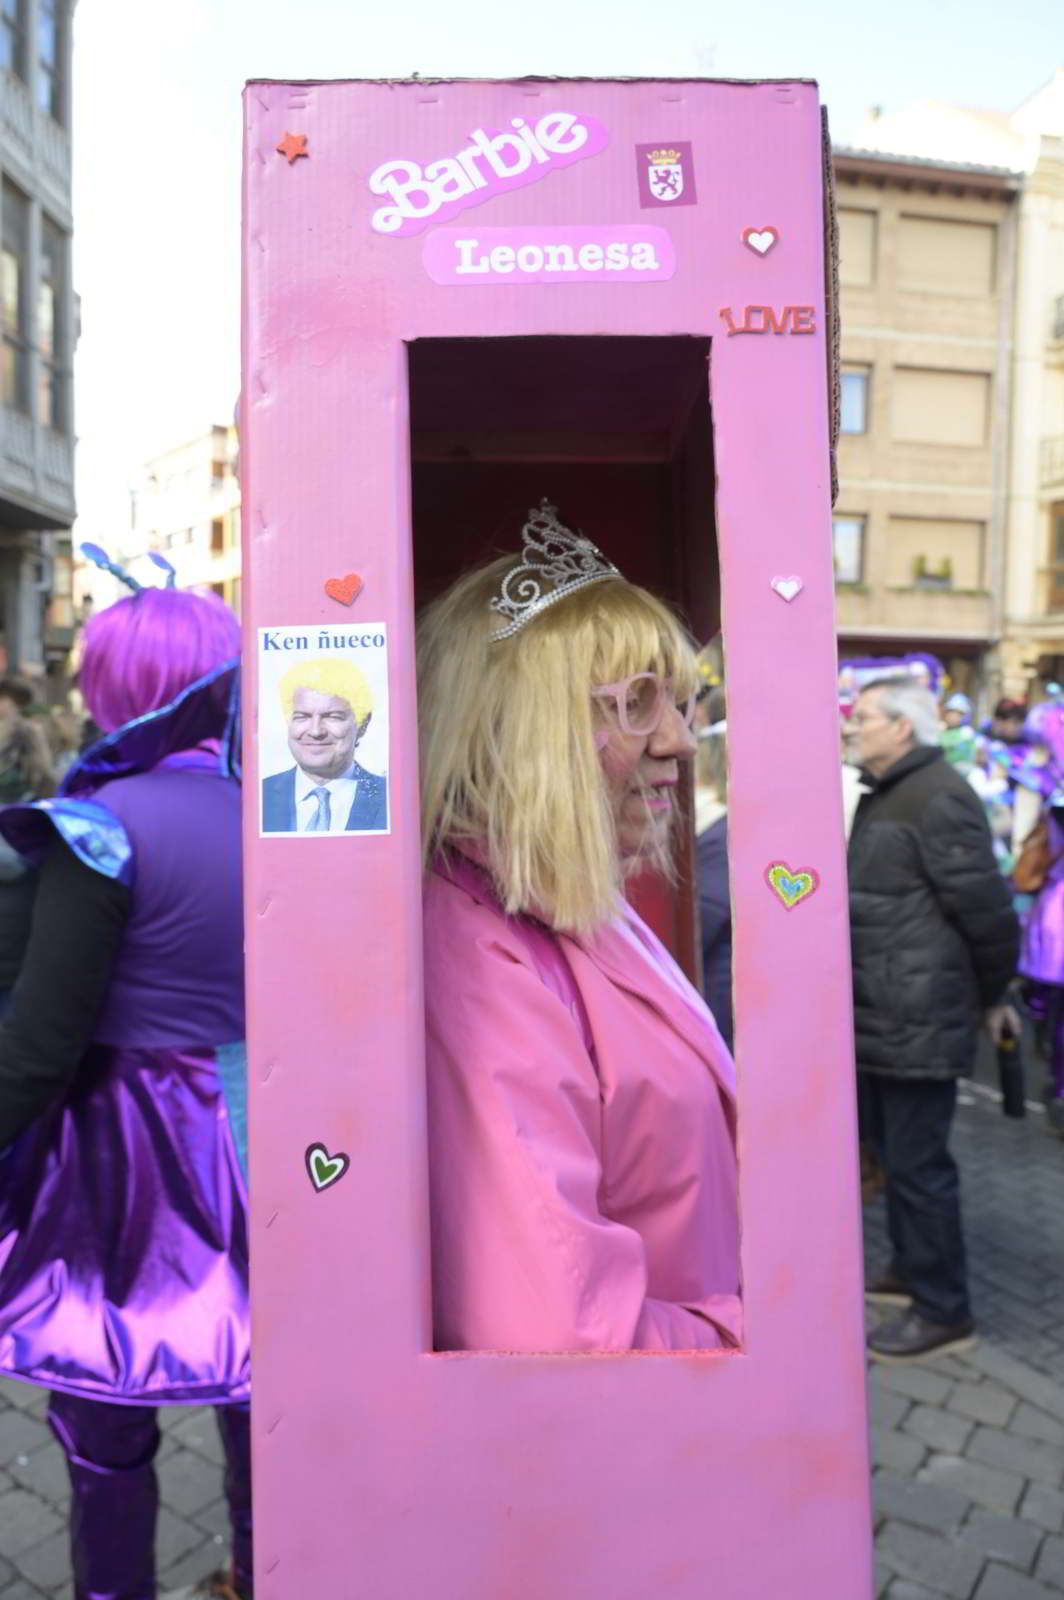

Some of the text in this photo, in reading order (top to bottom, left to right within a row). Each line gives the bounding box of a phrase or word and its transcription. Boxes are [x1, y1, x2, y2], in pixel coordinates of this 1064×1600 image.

[369, 112, 589, 235] Barbie
[454, 239, 659, 275] Leonesa
[719, 304, 817, 336] LOVE
[263, 630, 386, 651] Ken ñueco
